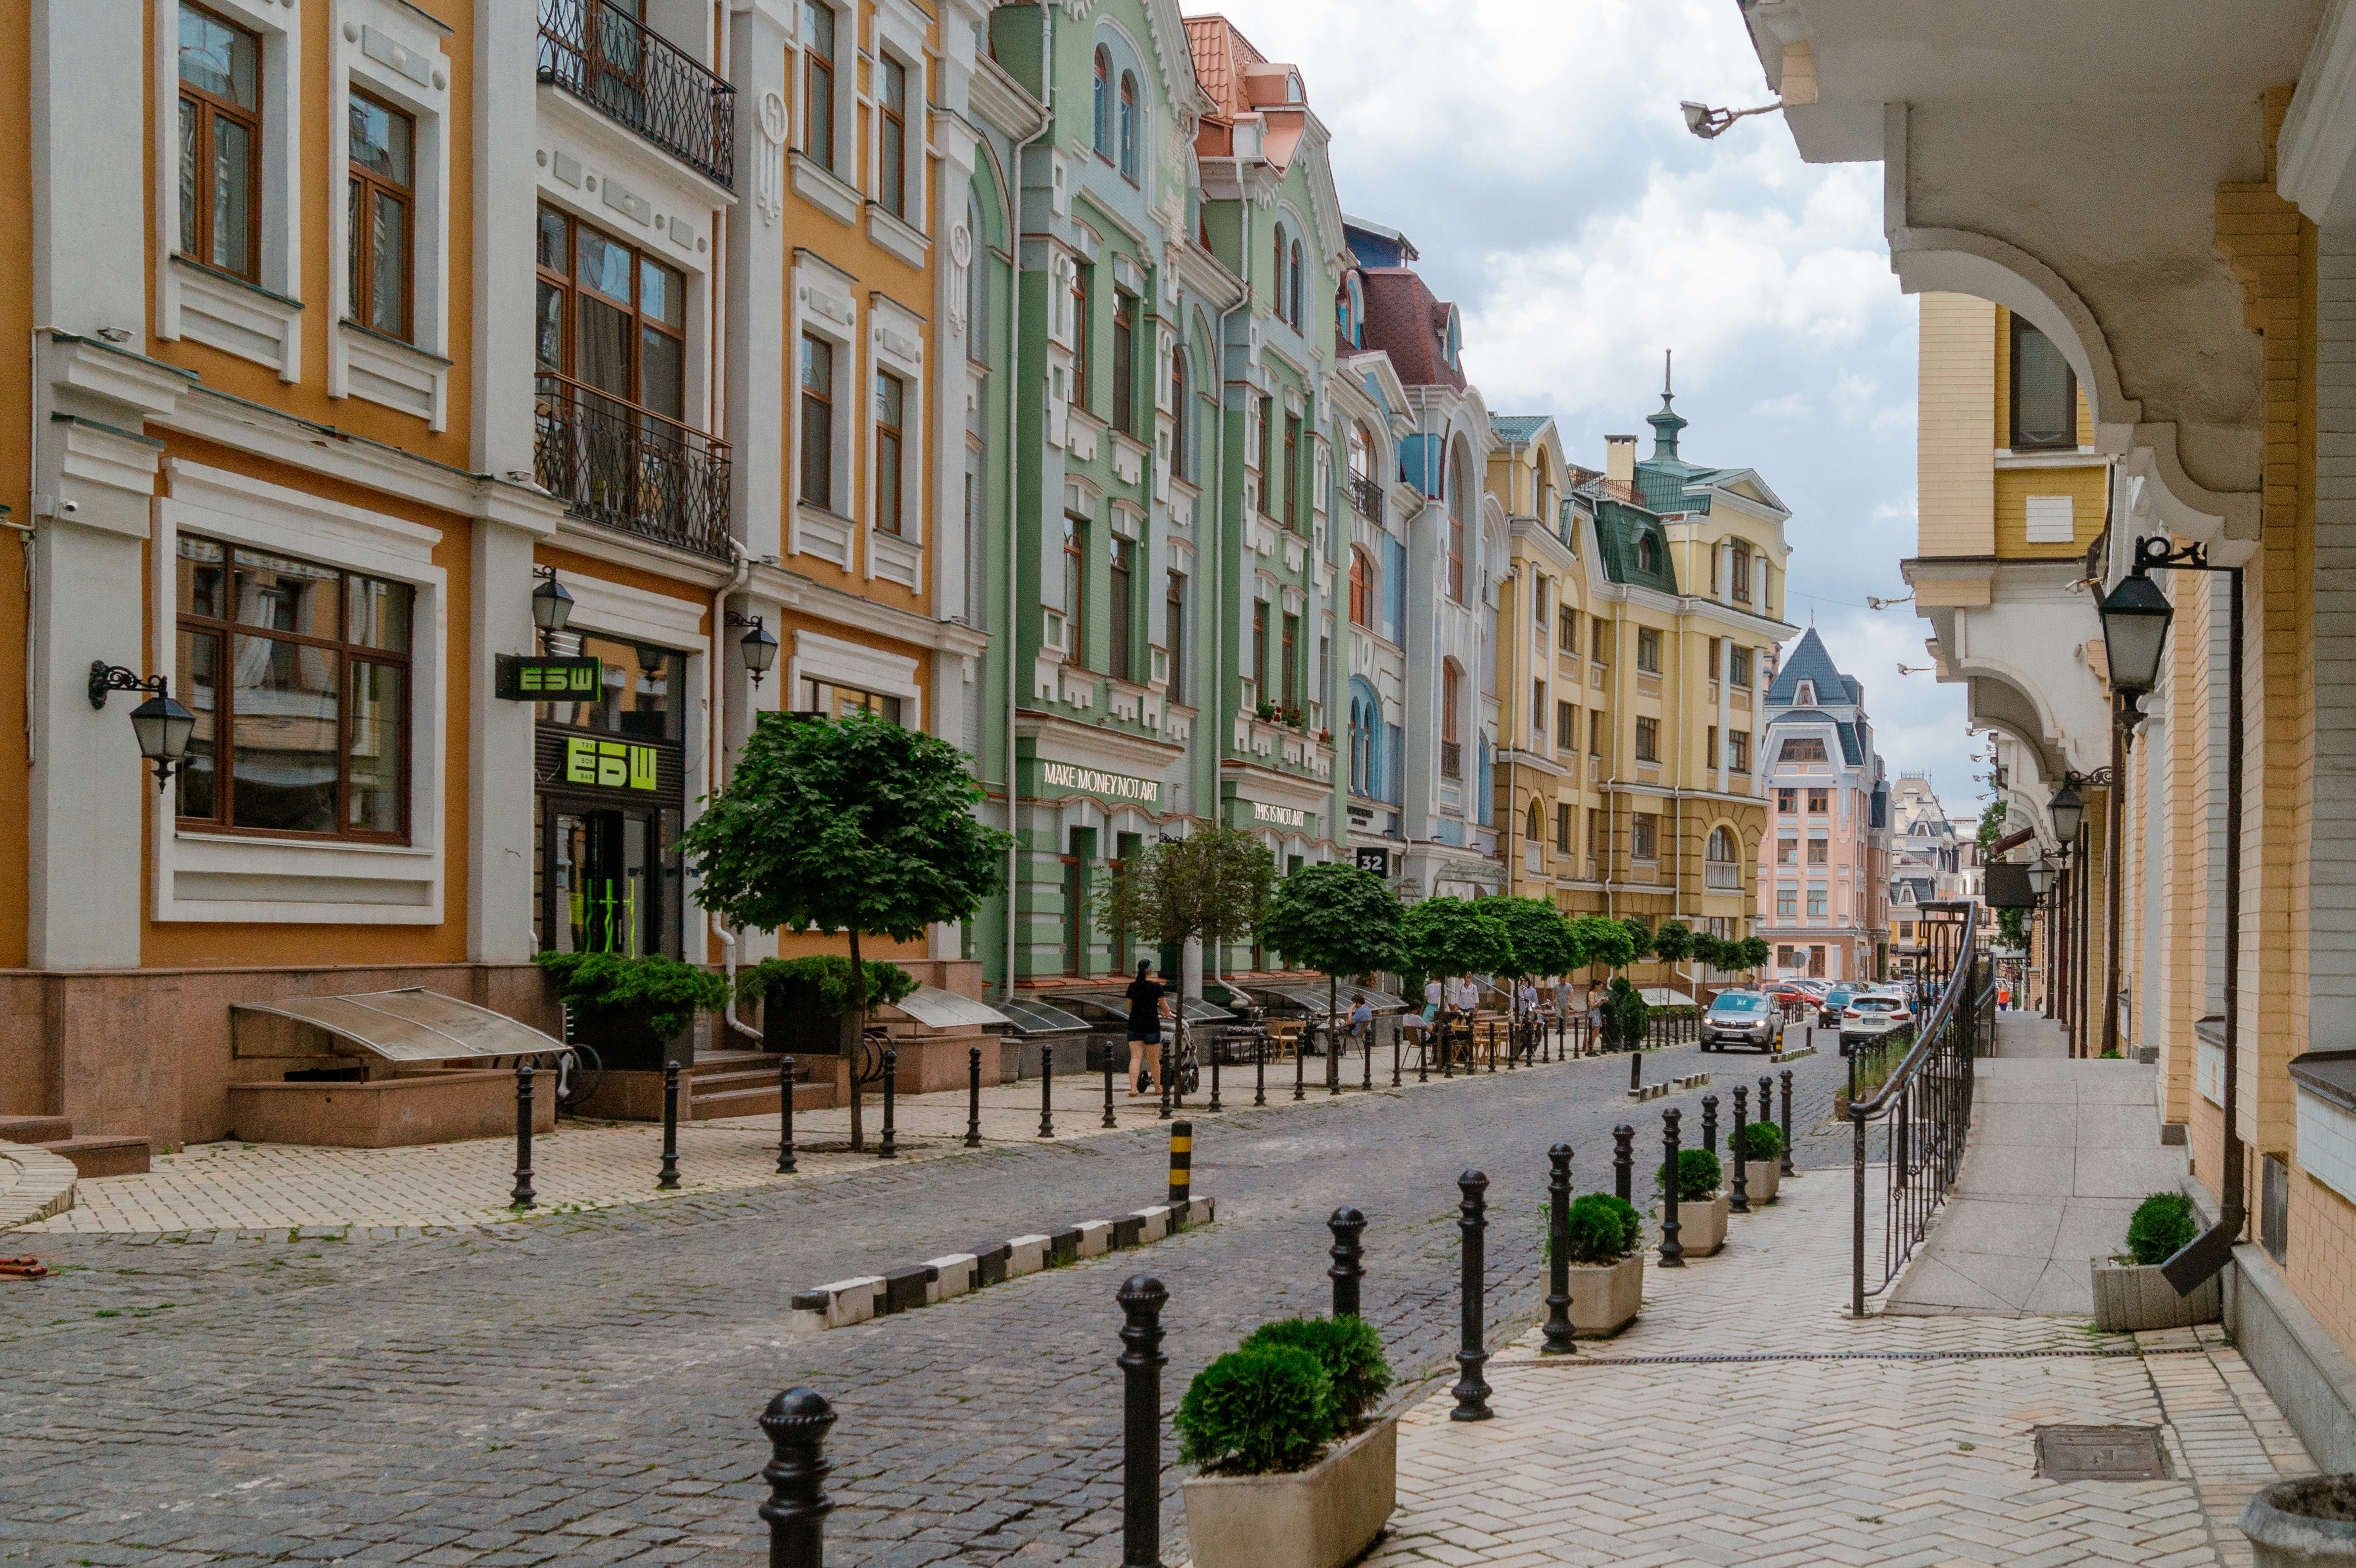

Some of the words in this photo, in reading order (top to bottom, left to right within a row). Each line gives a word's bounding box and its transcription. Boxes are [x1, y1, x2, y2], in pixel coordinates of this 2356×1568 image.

[1044, 762, 1076, 787] MAKE
[1077, 769, 1117, 794] MONEY
[1117, 776, 1140, 798] NOT
[1139, 781, 1158, 801] ART
[1253, 802, 1270, 821] THIS
[1270, 806, 1276, 823] IS
[1276, 807, 1292, 825] NOT
[1291, 810, 1305, 827] ART
[1361, 856, 1382, 871] 32
